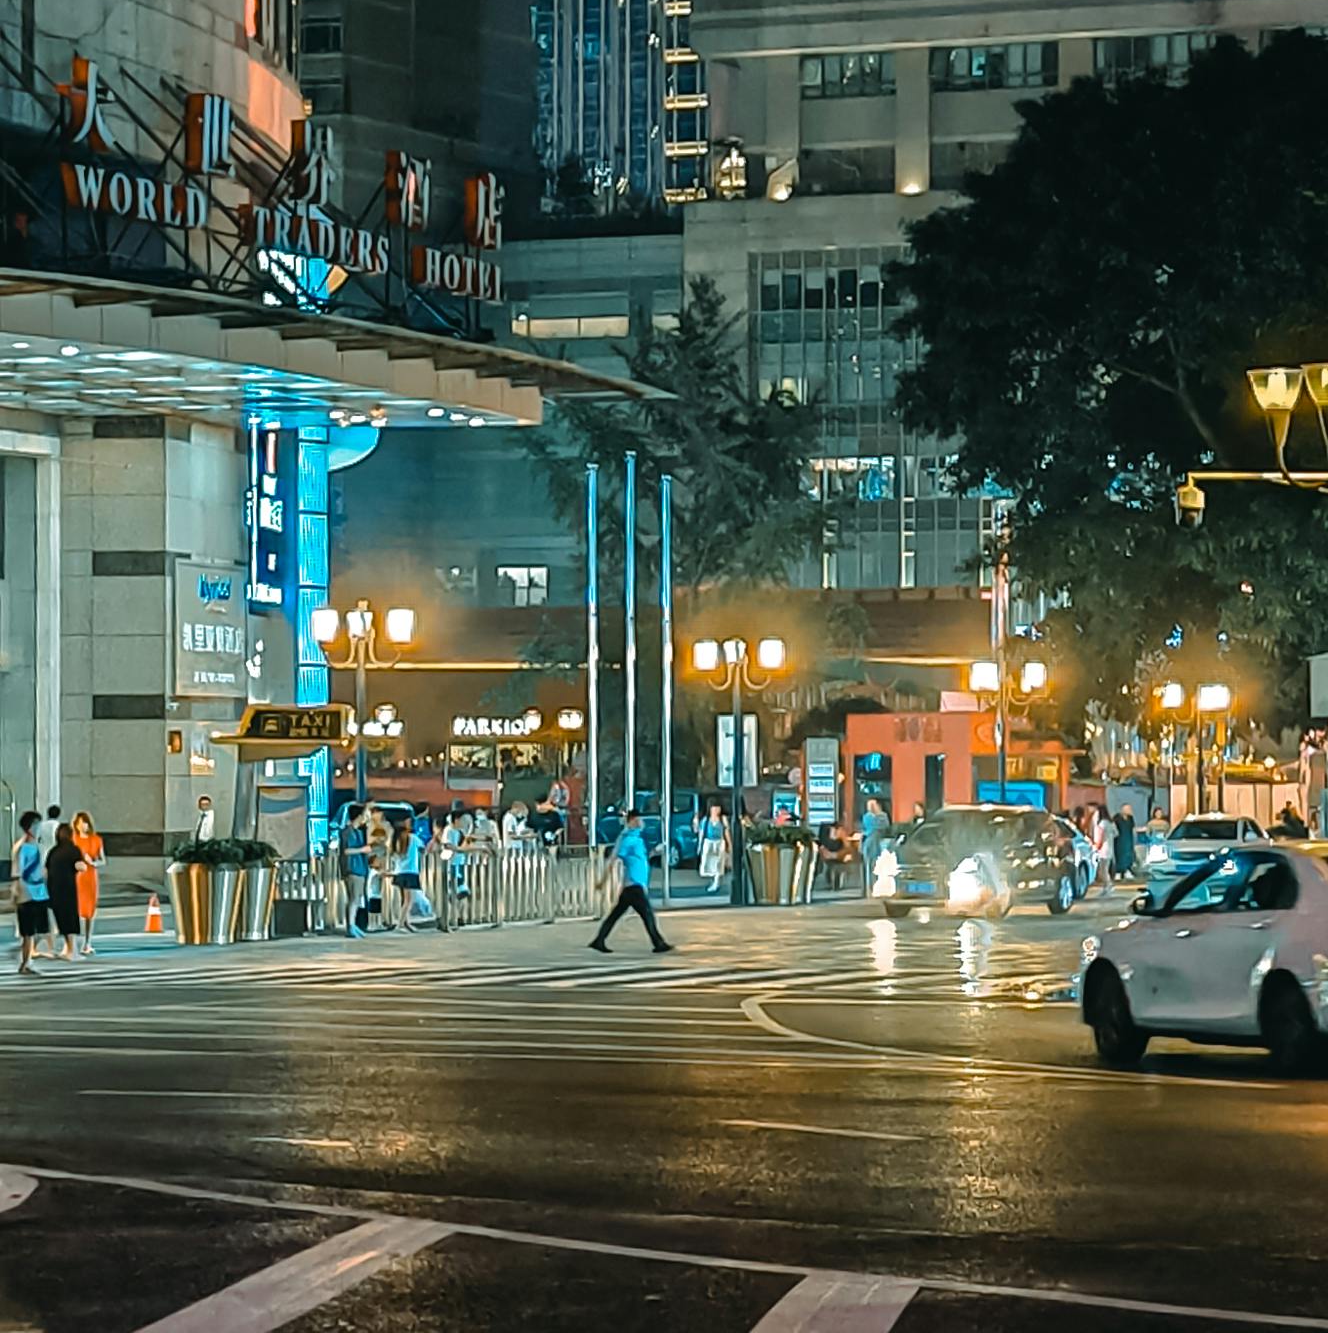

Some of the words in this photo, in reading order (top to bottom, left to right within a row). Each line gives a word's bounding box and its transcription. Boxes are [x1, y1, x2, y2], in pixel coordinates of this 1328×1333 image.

[73, 164, 207, 228] WORLD
[252, 204, 389, 276] TRADERS
[425, 246, 507, 306] HOTEL
[290, 714, 330, 727] TAXI
